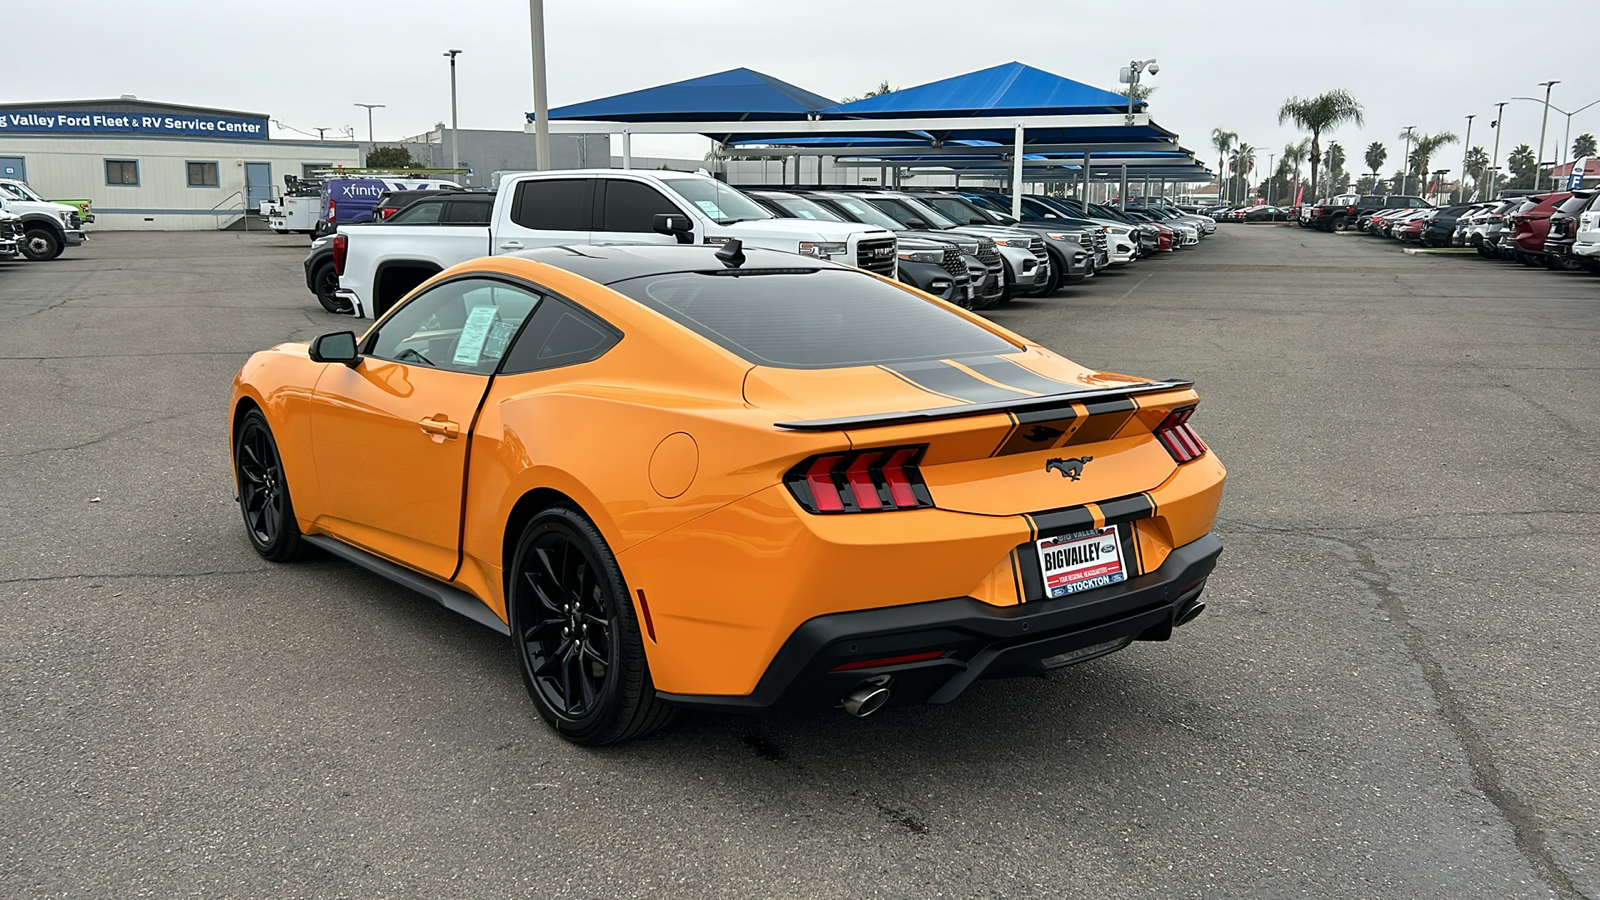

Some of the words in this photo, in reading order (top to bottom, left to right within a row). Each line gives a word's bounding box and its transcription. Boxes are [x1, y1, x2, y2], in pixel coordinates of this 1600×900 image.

[9, 114, 55, 128] Valley
[57, 115, 91, 127] Ford
[93, 115, 130, 127] Fleet
[131, 118, 140, 128] &
[142, 116, 162, 128] RV
[164, 117, 215, 131] Service
[217, 120, 261, 133] Center
[342, 183, 384, 198] xfinity
[1073, 529, 1099, 539] VALLEY
[1102, 545, 1115, 553] Ford
[1067, 576, 1109, 592] STOCKTON
